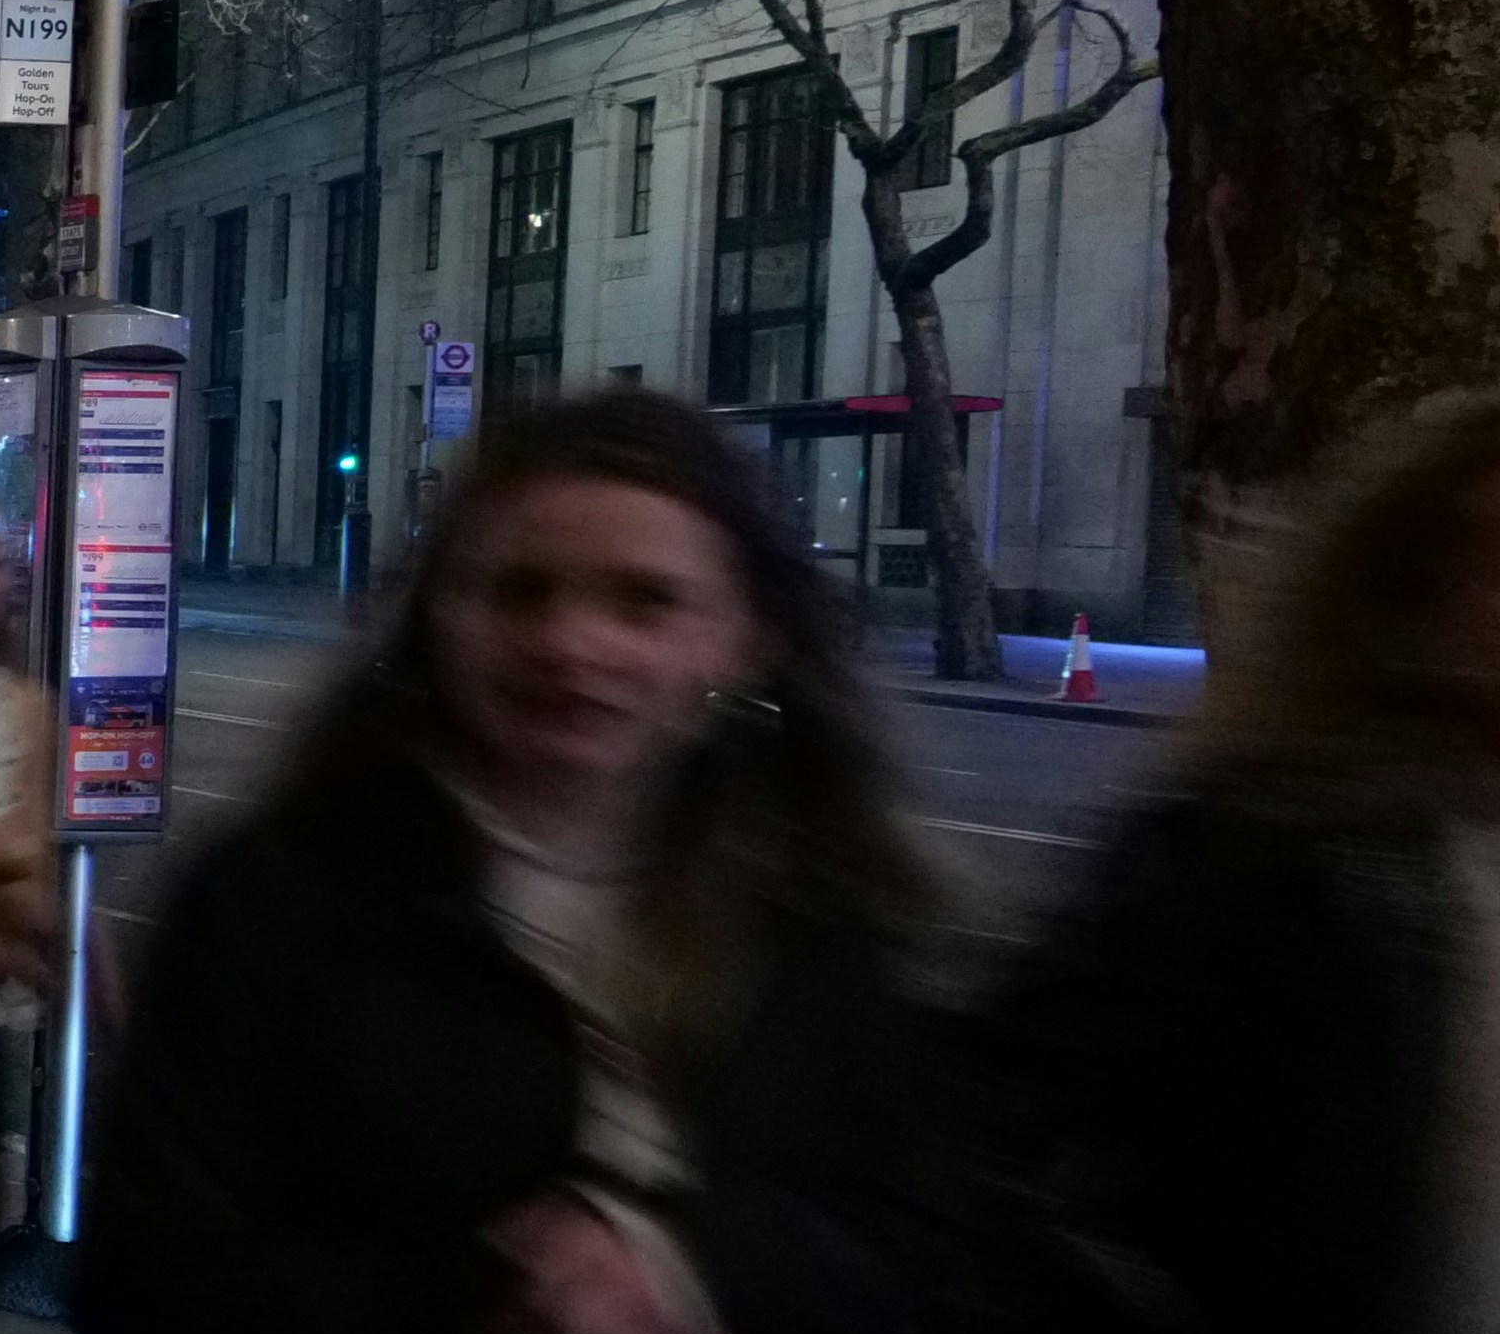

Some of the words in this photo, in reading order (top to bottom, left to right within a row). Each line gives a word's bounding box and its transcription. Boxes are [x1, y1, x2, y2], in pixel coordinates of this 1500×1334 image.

[6, 18, 68, 40] N199
[18, 67, 54, 78] Golden
[22, 80, 50, 92] Tours
[15, 93, 55, 106] Hop-On
[12, 105, 56, 118] Hop-Off
[424, 323, 437, 338] R
